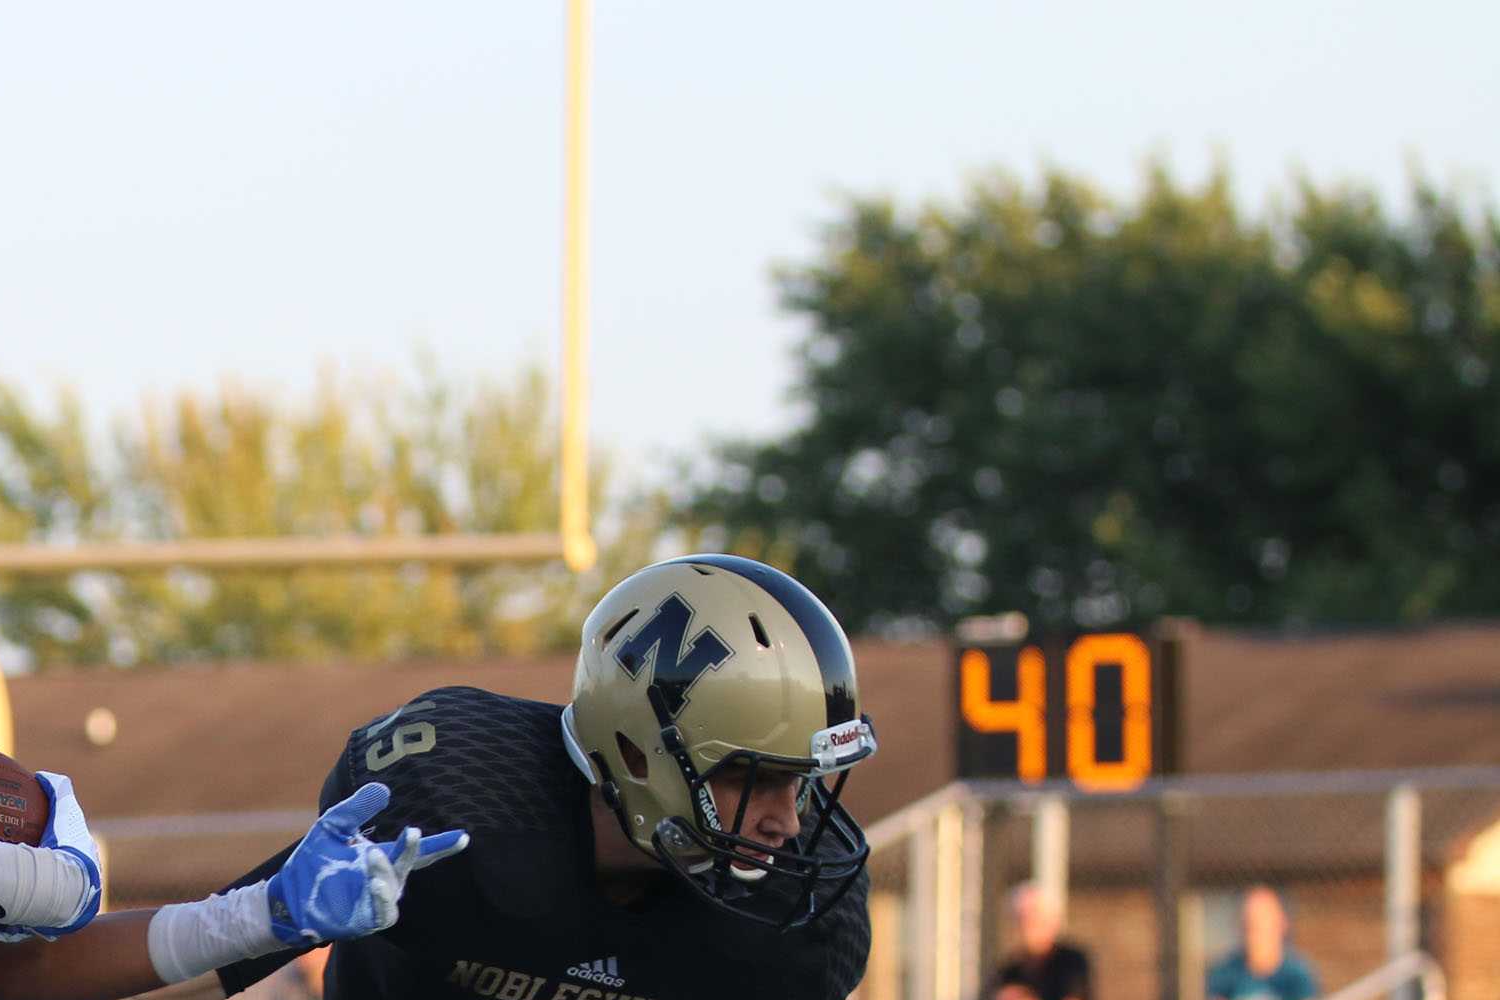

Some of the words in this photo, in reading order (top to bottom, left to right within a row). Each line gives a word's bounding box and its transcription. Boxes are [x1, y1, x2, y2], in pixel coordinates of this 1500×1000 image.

[615, 592, 735, 719] N
[961, 633, 1152, 794] 40
[566, 966, 626, 988] adidas
